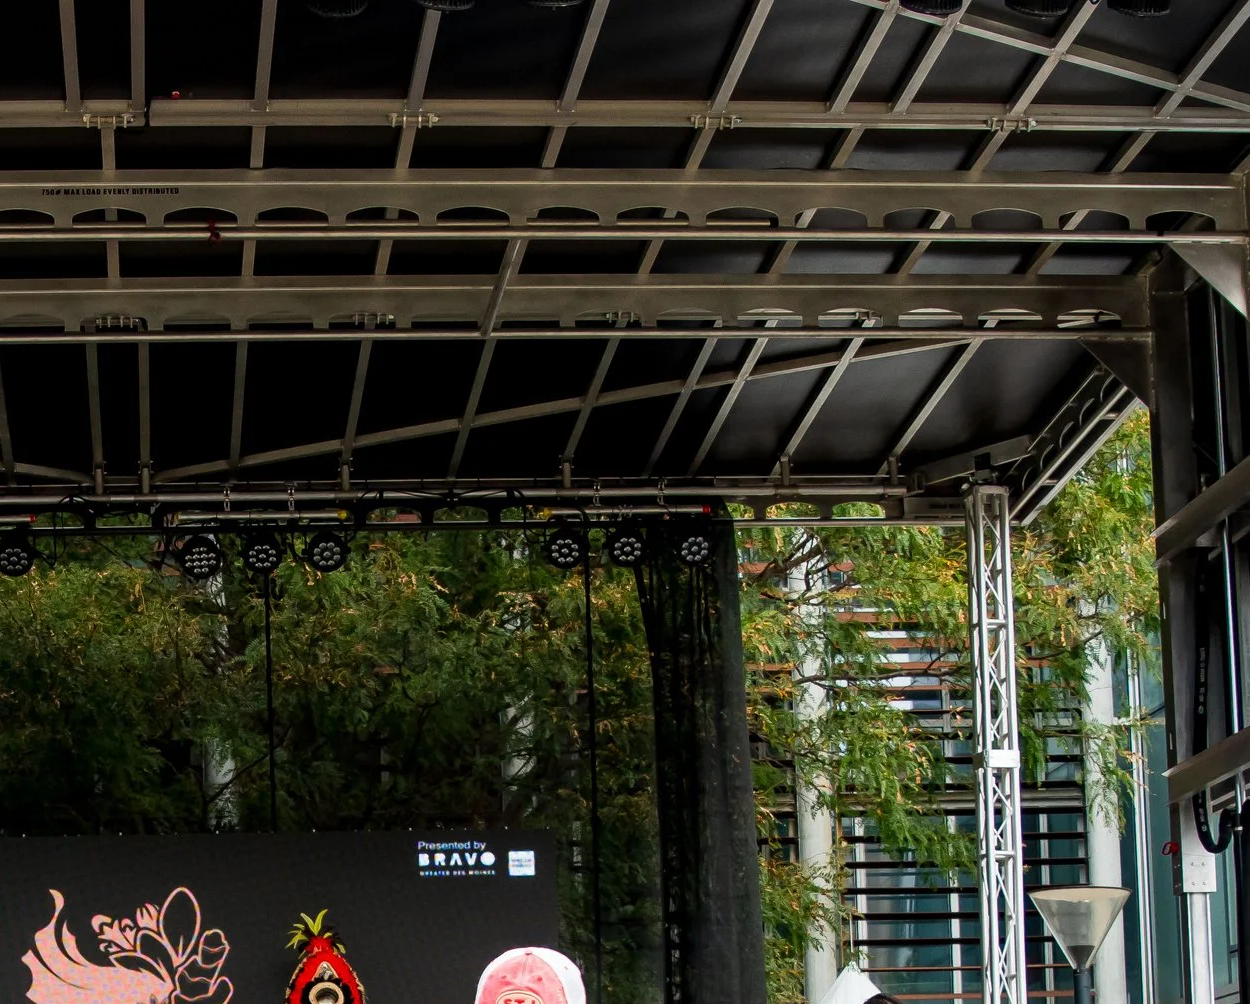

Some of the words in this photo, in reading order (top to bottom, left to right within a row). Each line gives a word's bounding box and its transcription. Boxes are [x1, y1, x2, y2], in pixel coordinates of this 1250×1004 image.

[63, 188, 81, 196] MAX
[81, 188, 101, 196] LOAD
[131, 187, 180, 195] DISTRIBUTED
[417, 841, 471, 850] Presented
[473, 841, 487, 851] by
[418, 851, 496, 867] BRAVO
